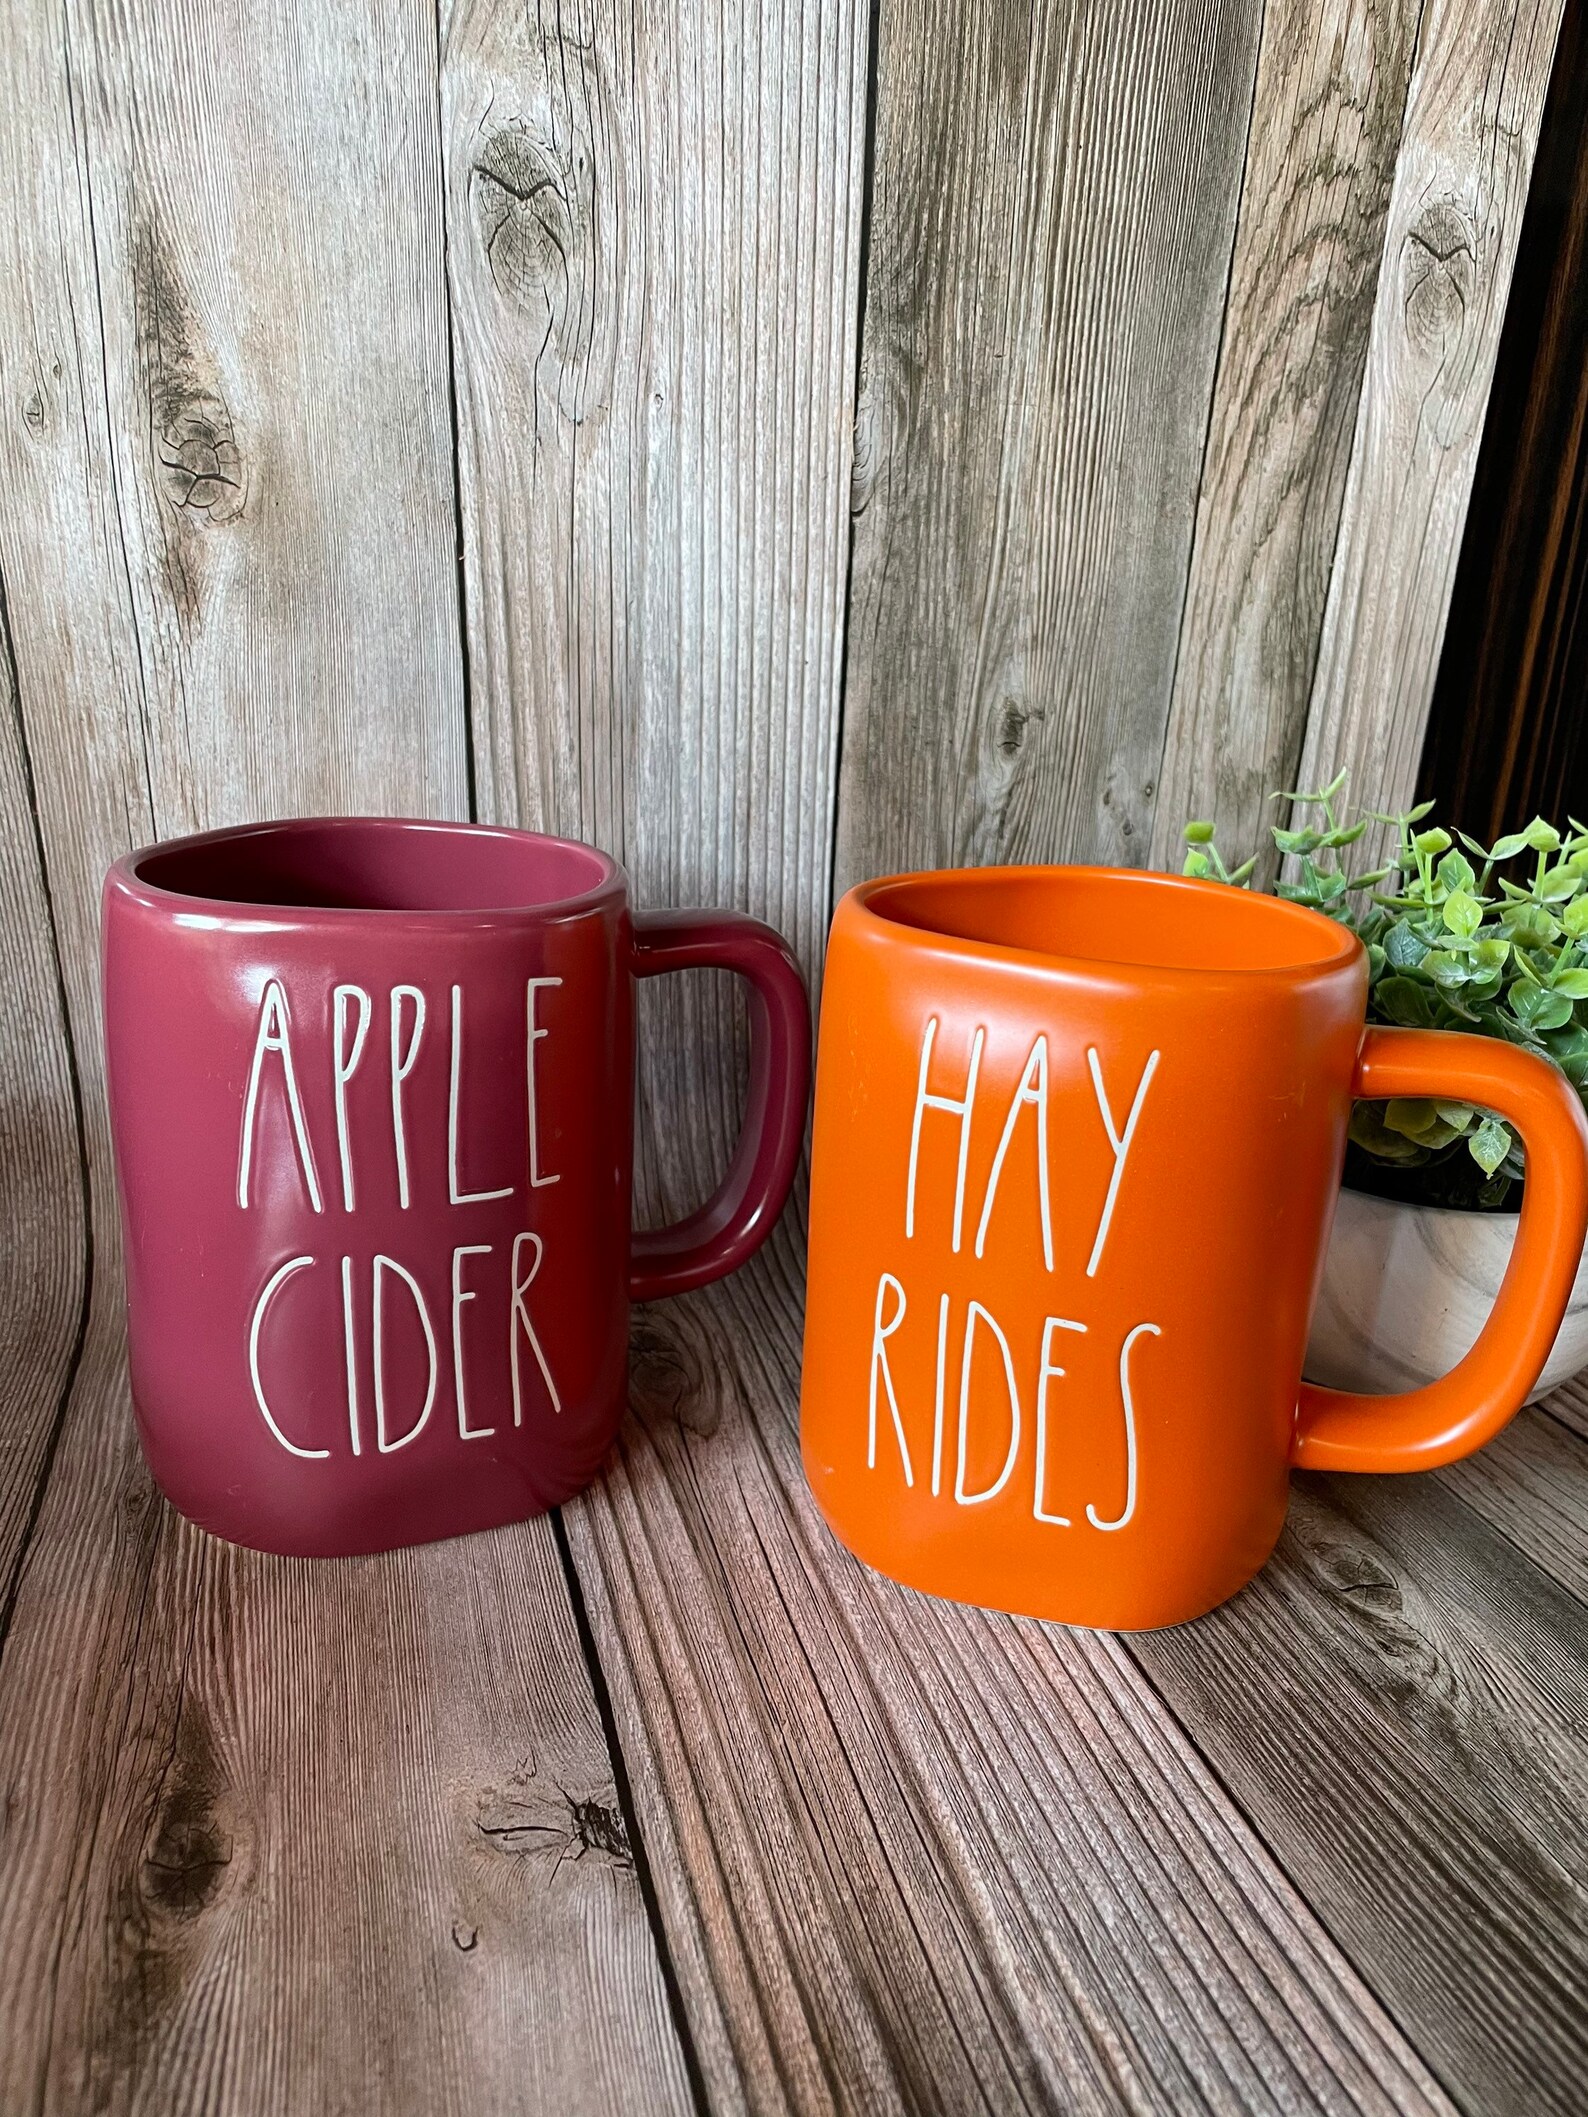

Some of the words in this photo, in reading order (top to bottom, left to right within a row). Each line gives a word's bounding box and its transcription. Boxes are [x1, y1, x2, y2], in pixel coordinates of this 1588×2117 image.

[236, 976, 564, 1214] APPLE
[905, 1015, 1161, 1278] HAY
[248, 1231, 562, 1460] CIDER
[867, 1272, 1162, 1532] RIDES
